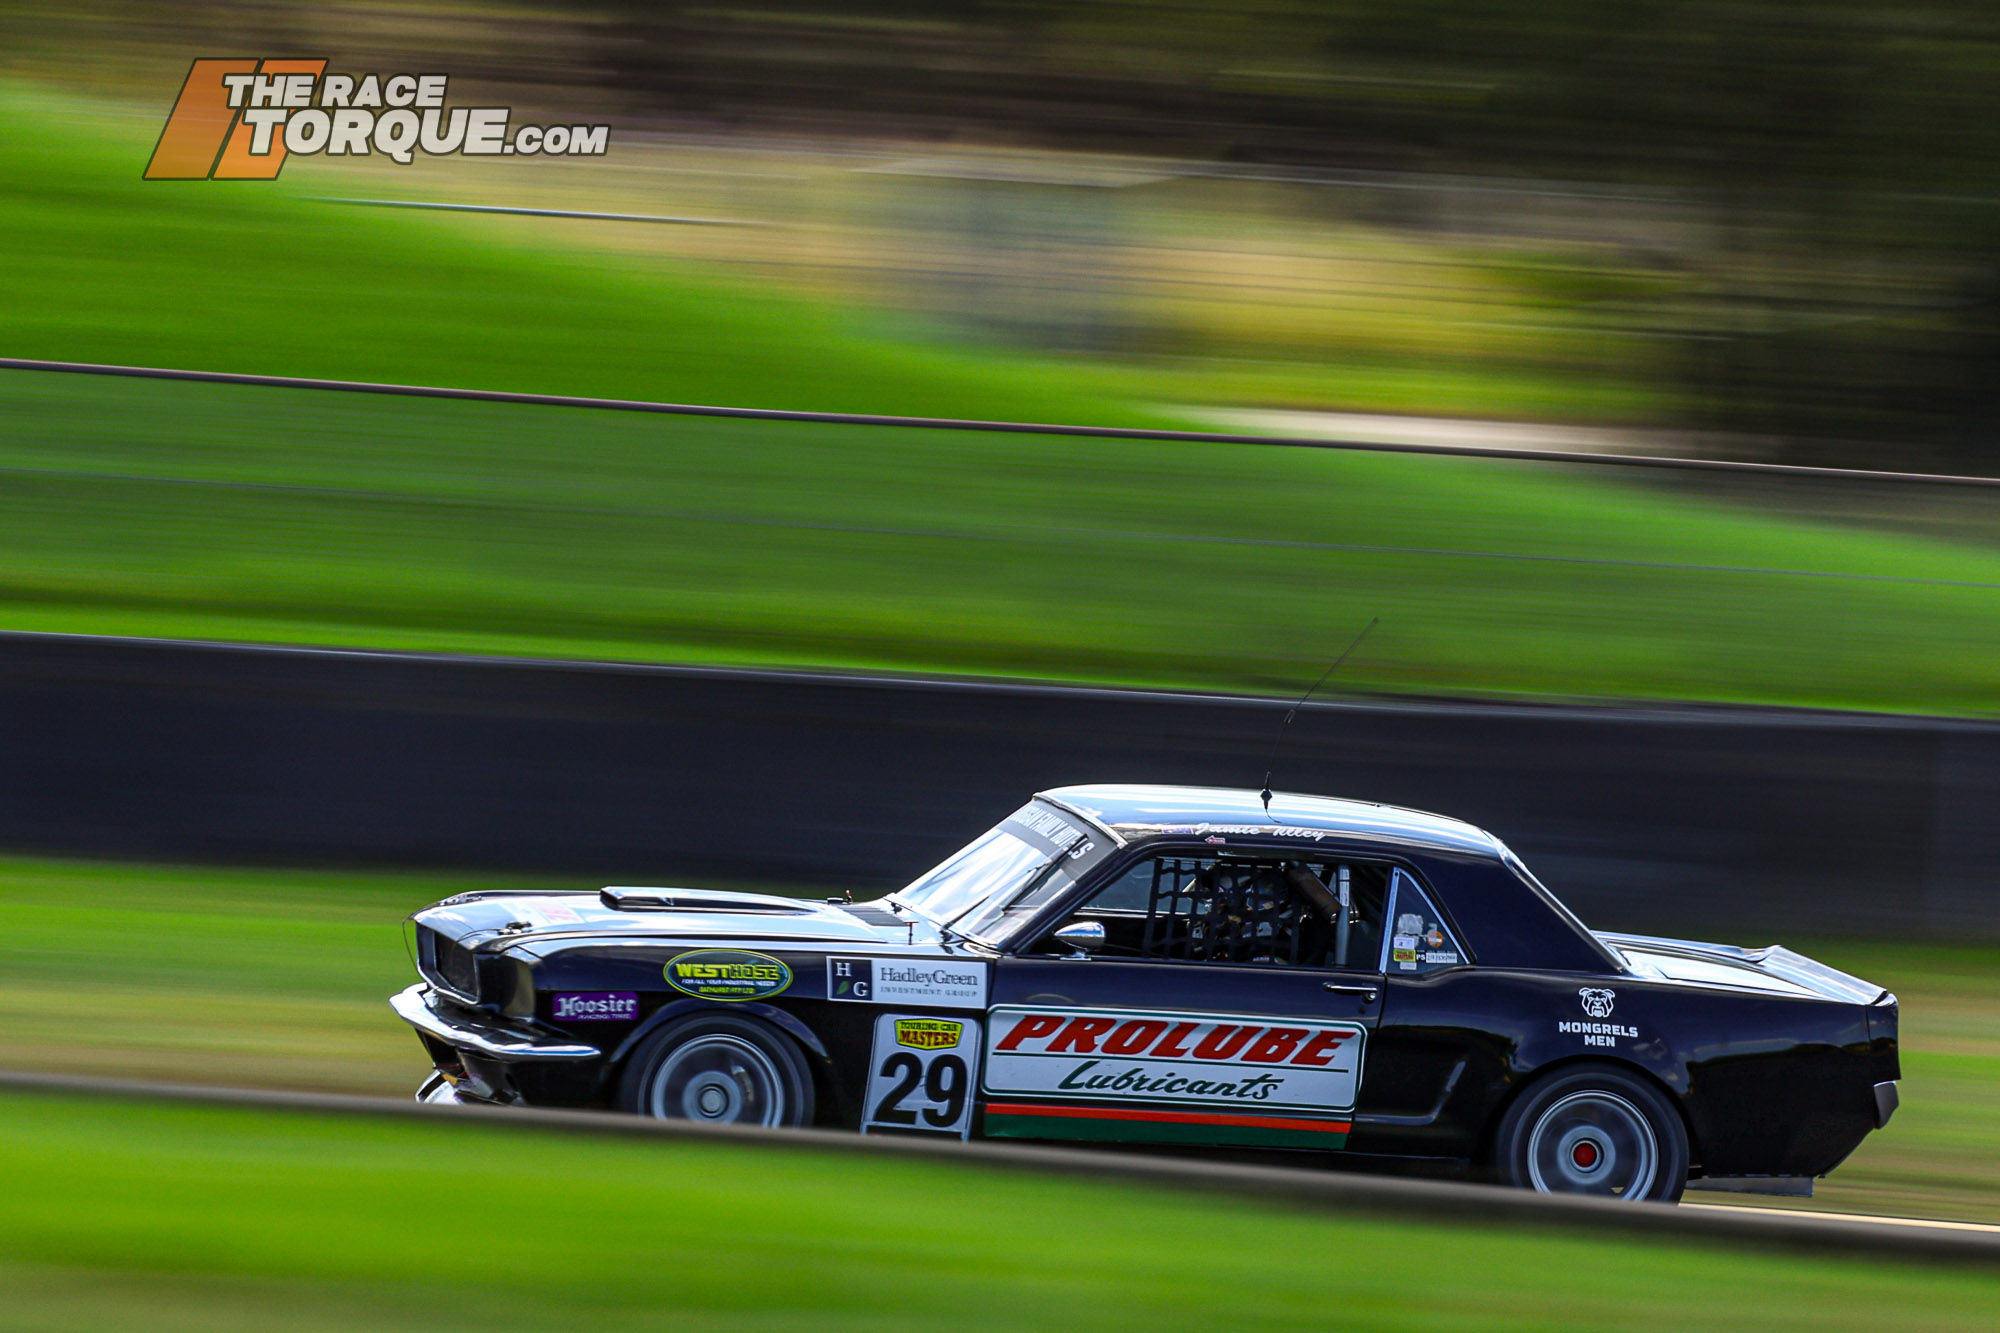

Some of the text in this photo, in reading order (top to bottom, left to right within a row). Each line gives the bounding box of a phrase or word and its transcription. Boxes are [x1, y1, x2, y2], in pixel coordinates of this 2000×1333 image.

[1195, 822, 1261, 835] Jamie
[676, 963, 780, 980] WESTHOSE
[835, 962, 851, 977] H
[880, 967, 978, 987] HadleyGreen
[853, 981, 869, 997] G
[880, 986, 977, 997] INVESTMENT GROUP
[554, 994, 636, 1016] Hoosier
[901, 1022, 958, 1032] TOURING CAR
[1559, 1021, 1638, 1038] MONGRELS
[899, 1030, 957, 1047] MASTERS
[995, 1015, 1357, 1066] PROLUBE
[1584, 1035, 1616, 1047] MEN
[1057, 1060, 1284, 1100] Lubricants
[872, 1051, 968, 1128] 29
